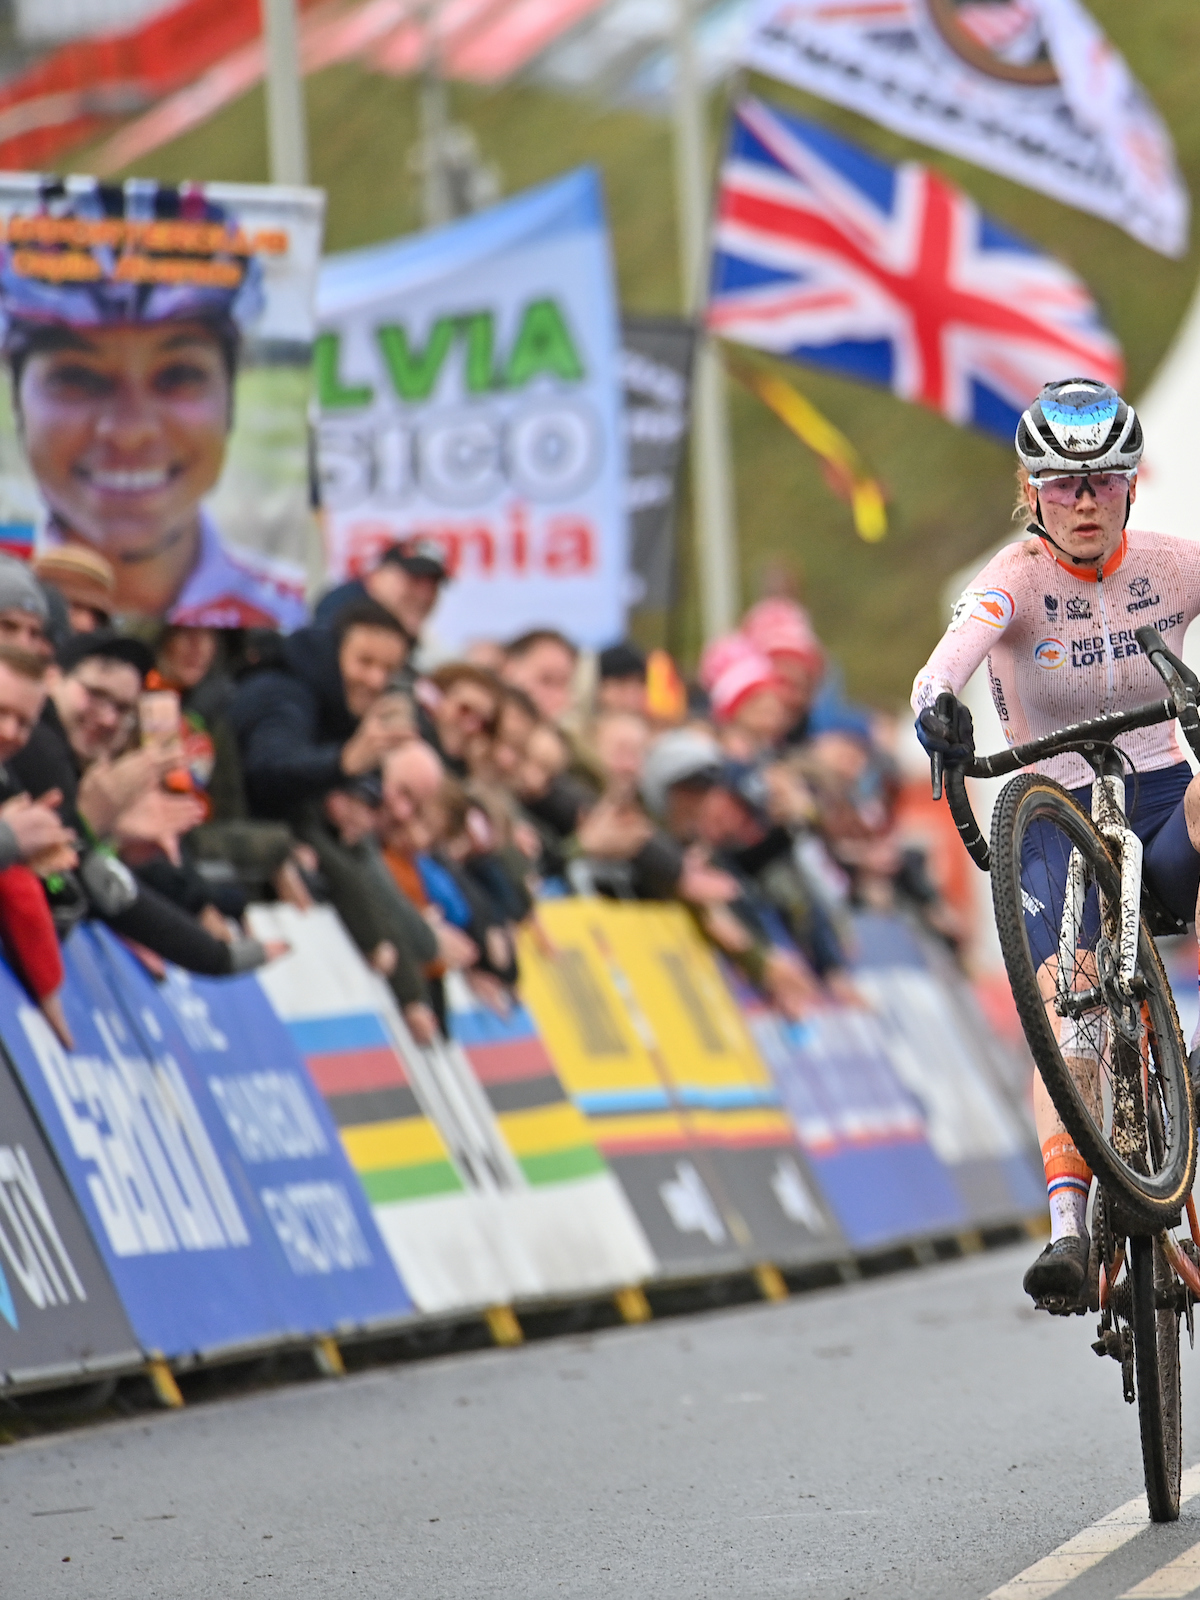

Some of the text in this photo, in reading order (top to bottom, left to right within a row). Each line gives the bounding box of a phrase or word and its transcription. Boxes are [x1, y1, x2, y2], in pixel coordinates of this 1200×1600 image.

[313, 298, 586, 409] LVIA
[318, 405, 604, 506] SICO
[1127, 595, 1160, 613] AGU
[1072, 611, 1185, 652] NEDERLDSE
[1072, 642, 1146, 668] LOTERI
